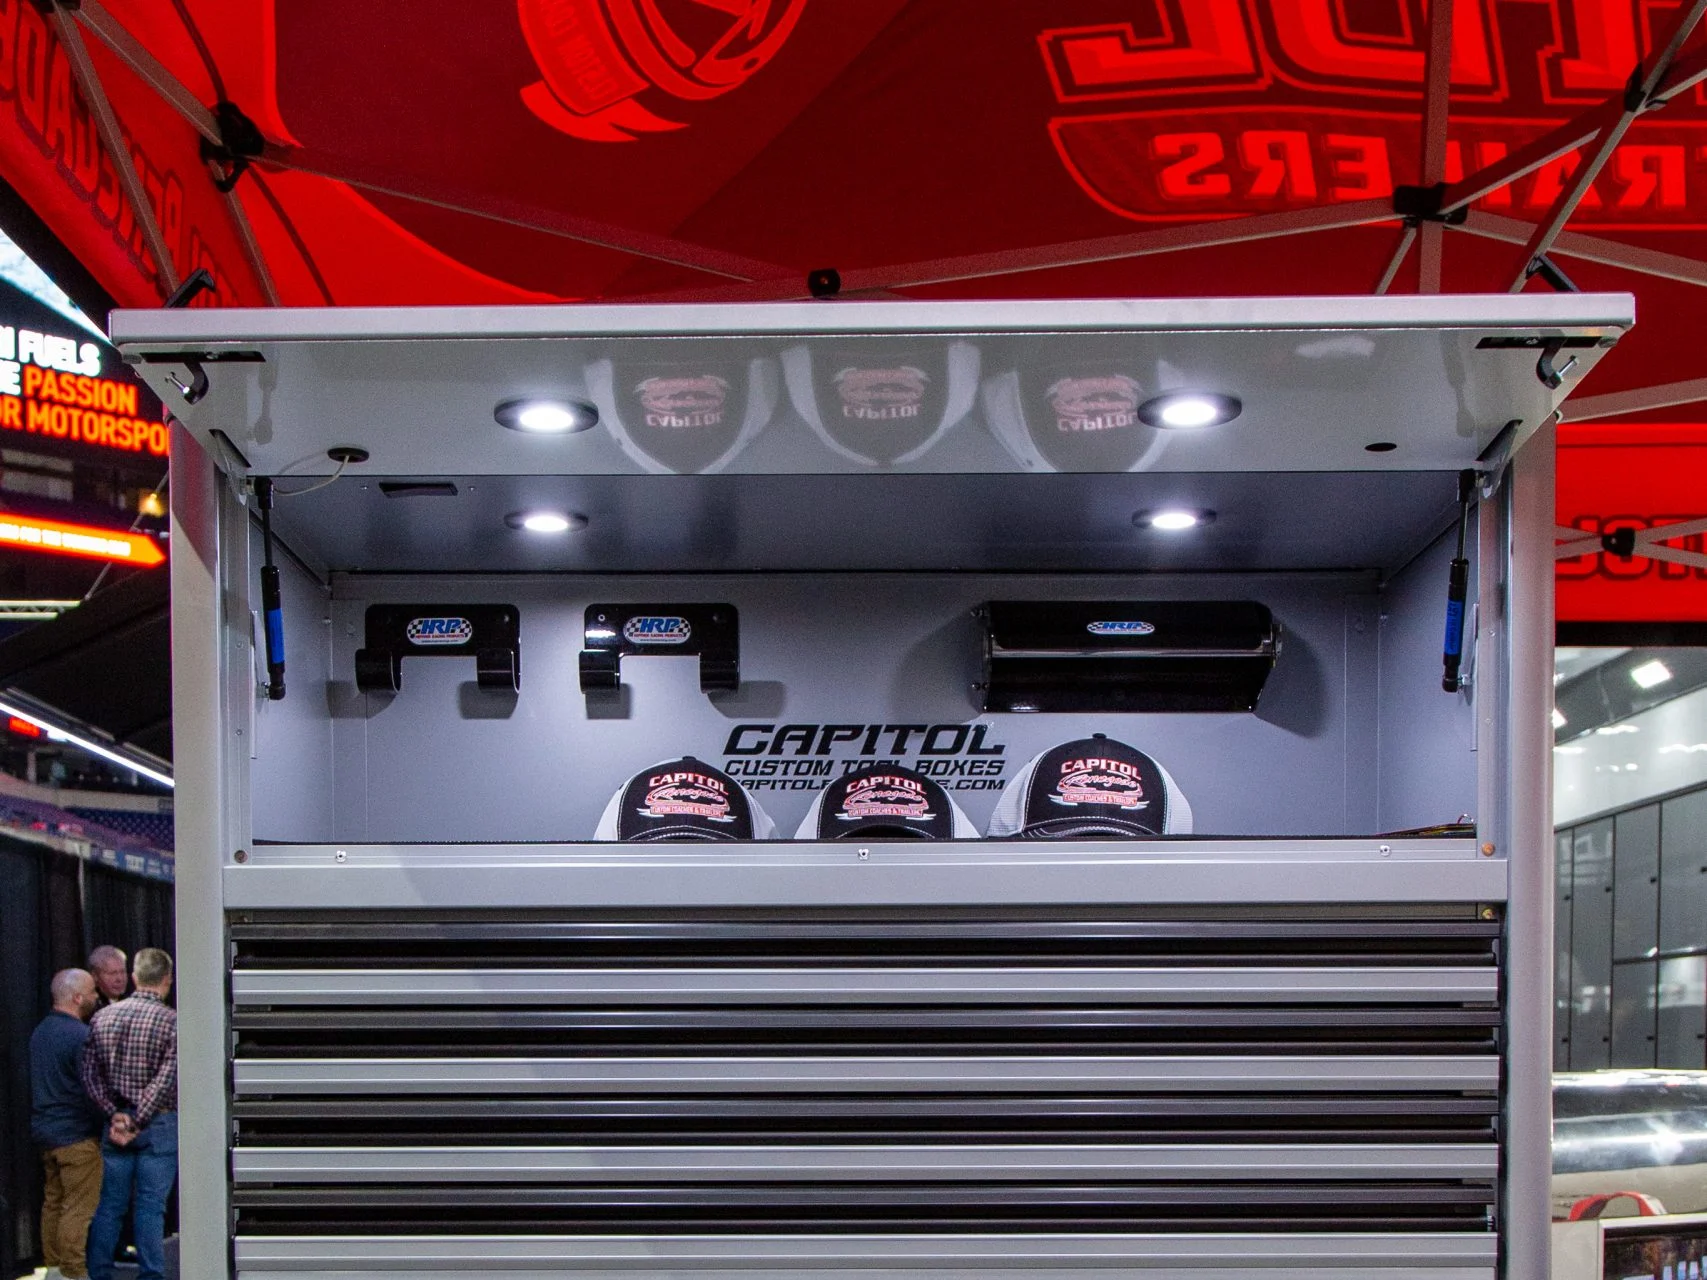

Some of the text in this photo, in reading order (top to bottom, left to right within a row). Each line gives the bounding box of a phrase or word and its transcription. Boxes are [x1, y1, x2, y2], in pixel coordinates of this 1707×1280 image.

[24, 365, 137, 416] PASSION
[26, 400, 169, 457] MOTORSPO
[421, 619, 462, 634] HRP
[640, 618, 681, 633] HRP
[723, 724, 1005, 755] CAPITOL
[724, 760, 834, 776] CUSTOM
[914, 760, 1005, 776] BOXES
[1061, 759, 1142, 780] CAPITOL
[649, 773, 729, 795] CAPITOL
[846, 776, 927, 794] CAPITOL
